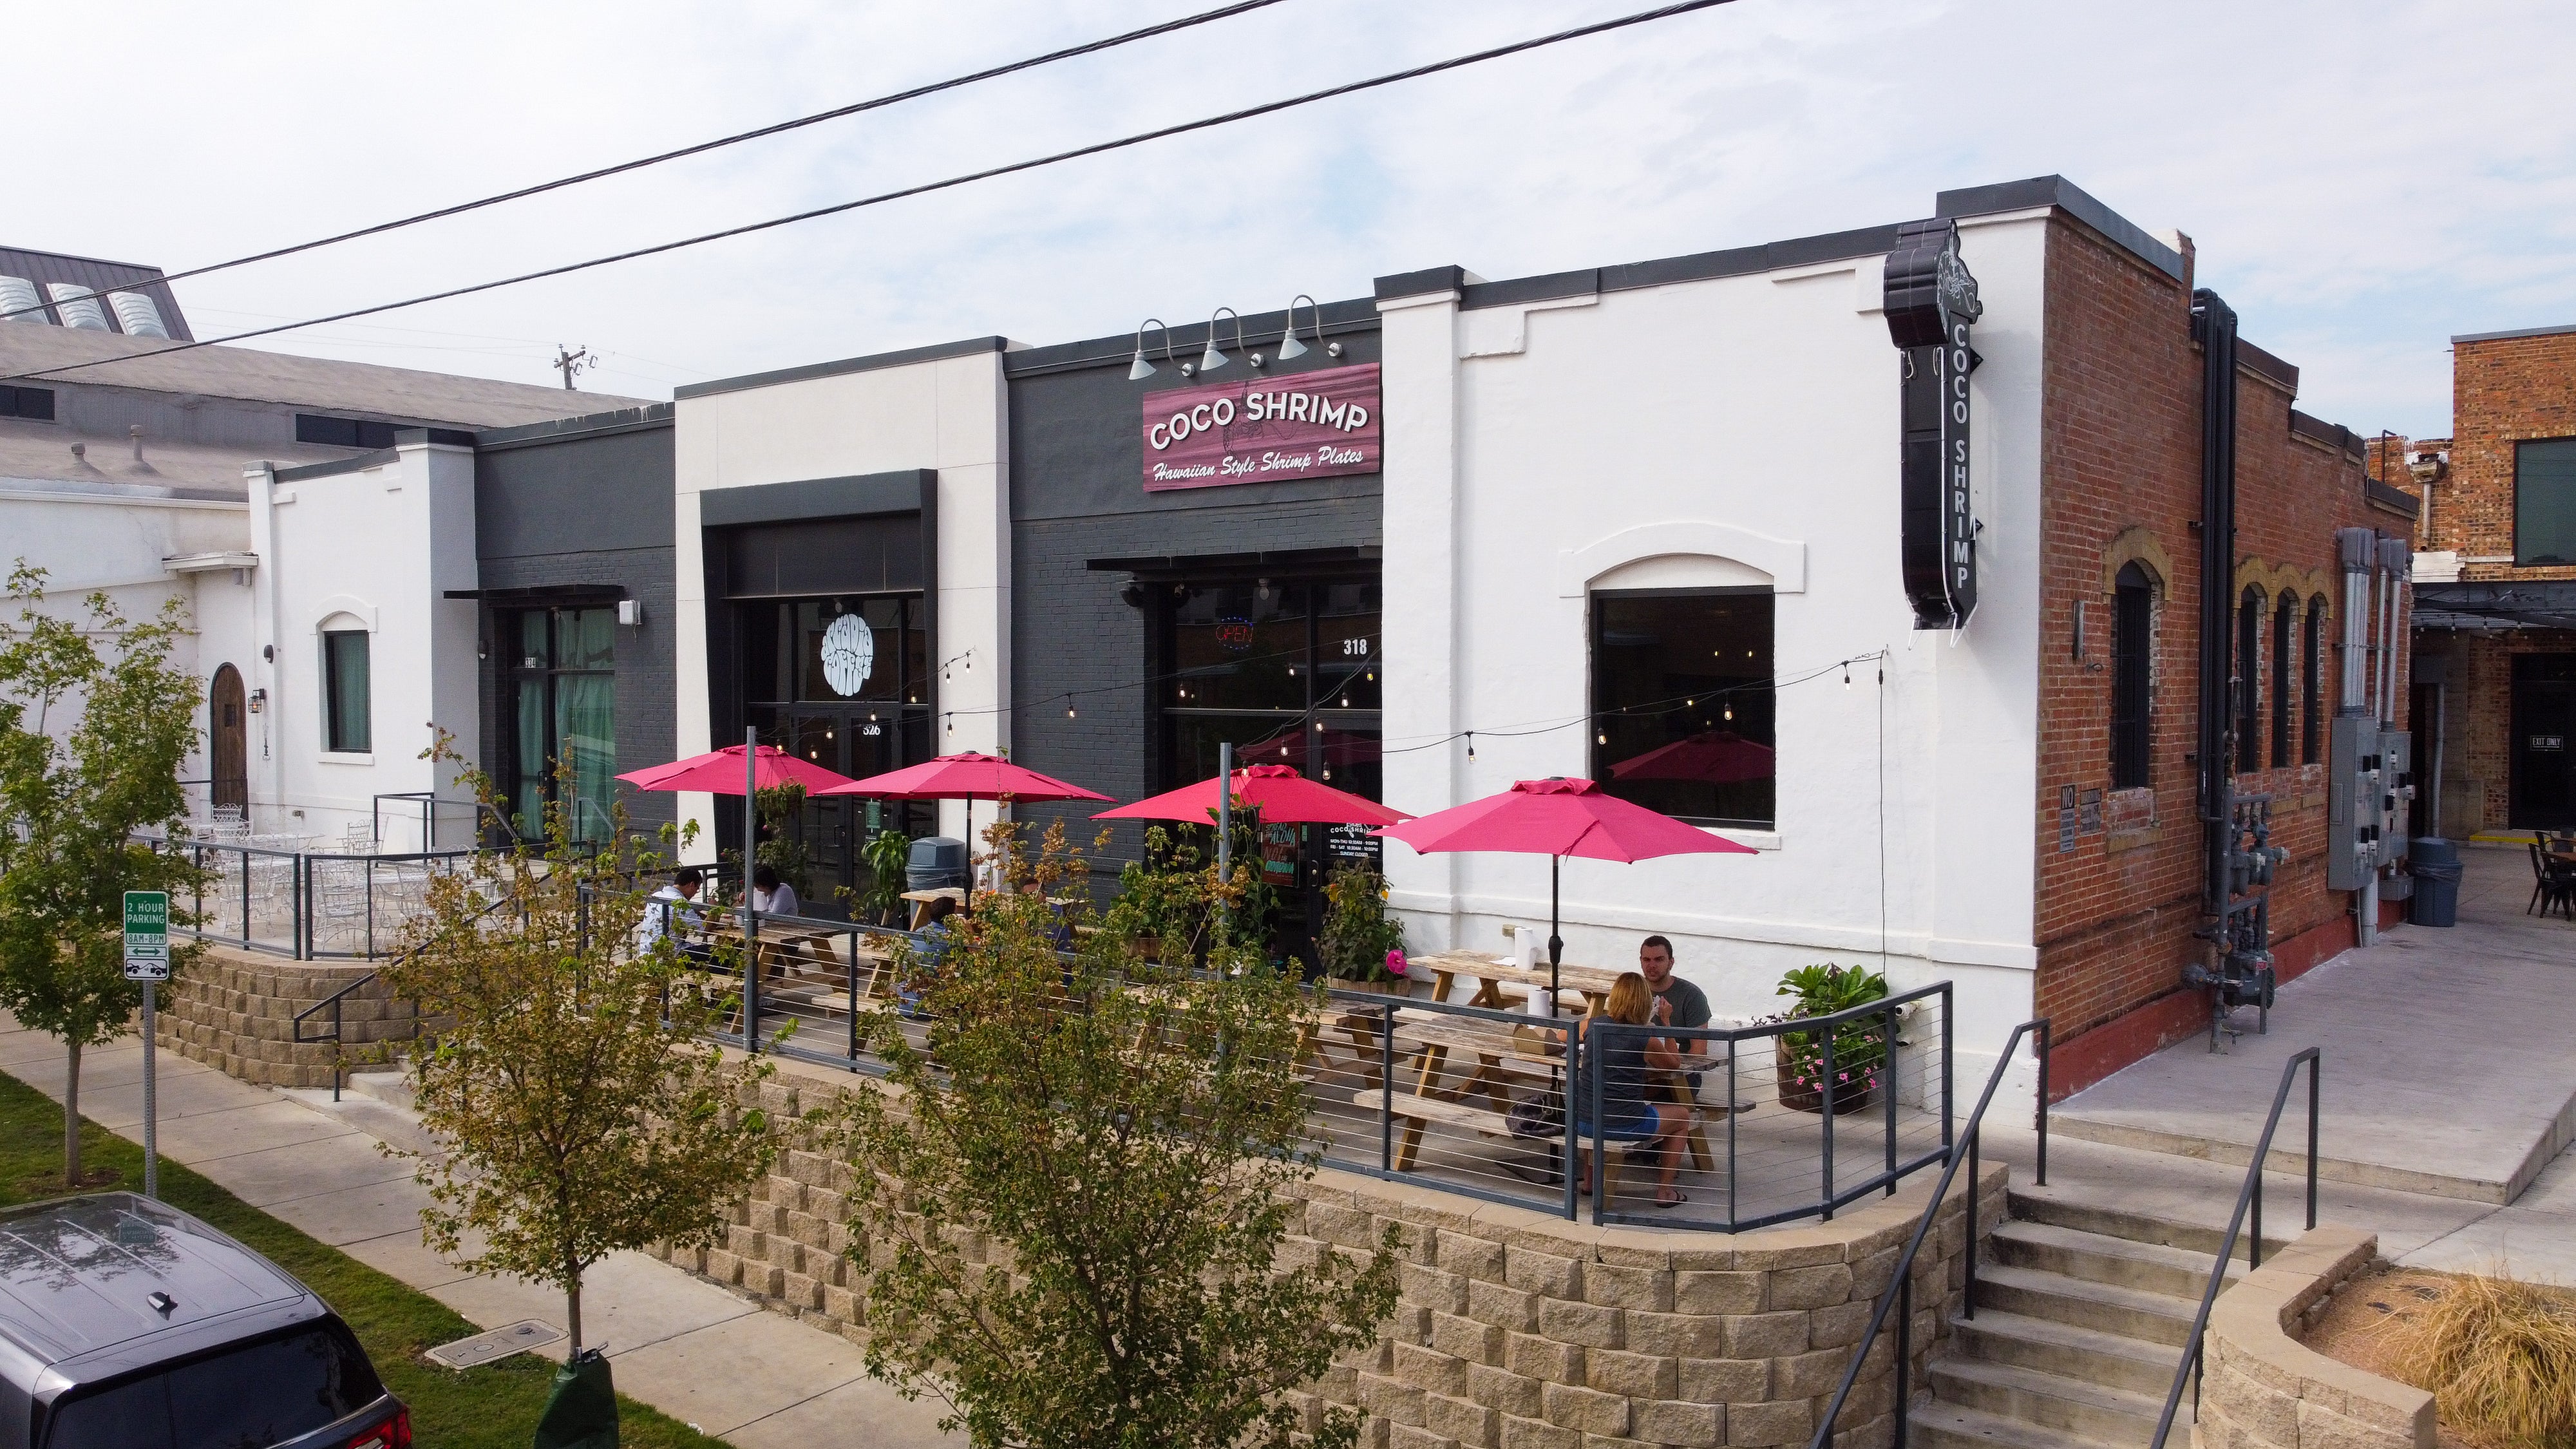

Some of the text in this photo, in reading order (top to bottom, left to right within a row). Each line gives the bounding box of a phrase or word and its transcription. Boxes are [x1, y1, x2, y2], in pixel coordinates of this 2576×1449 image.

[1150, 392, 1368, 450] COCO SHRIMP
[1153, 446, 1363, 481] Hawaiian Style Shrimp Plates
[1953, 324, 1968, 589] COCO SHRIMP
[1215, 625, 1254, 643] OPEN
[1343, 639, 1367, 655] 318
[2532, 737, 2561, 746] EXIT ONLY
[2062, 787, 2073, 809] NO
[1270, 827, 1296, 846] ALOHA
[128, 903, 164, 913] 2 HOUR
[127, 914, 165, 924] PARKING
